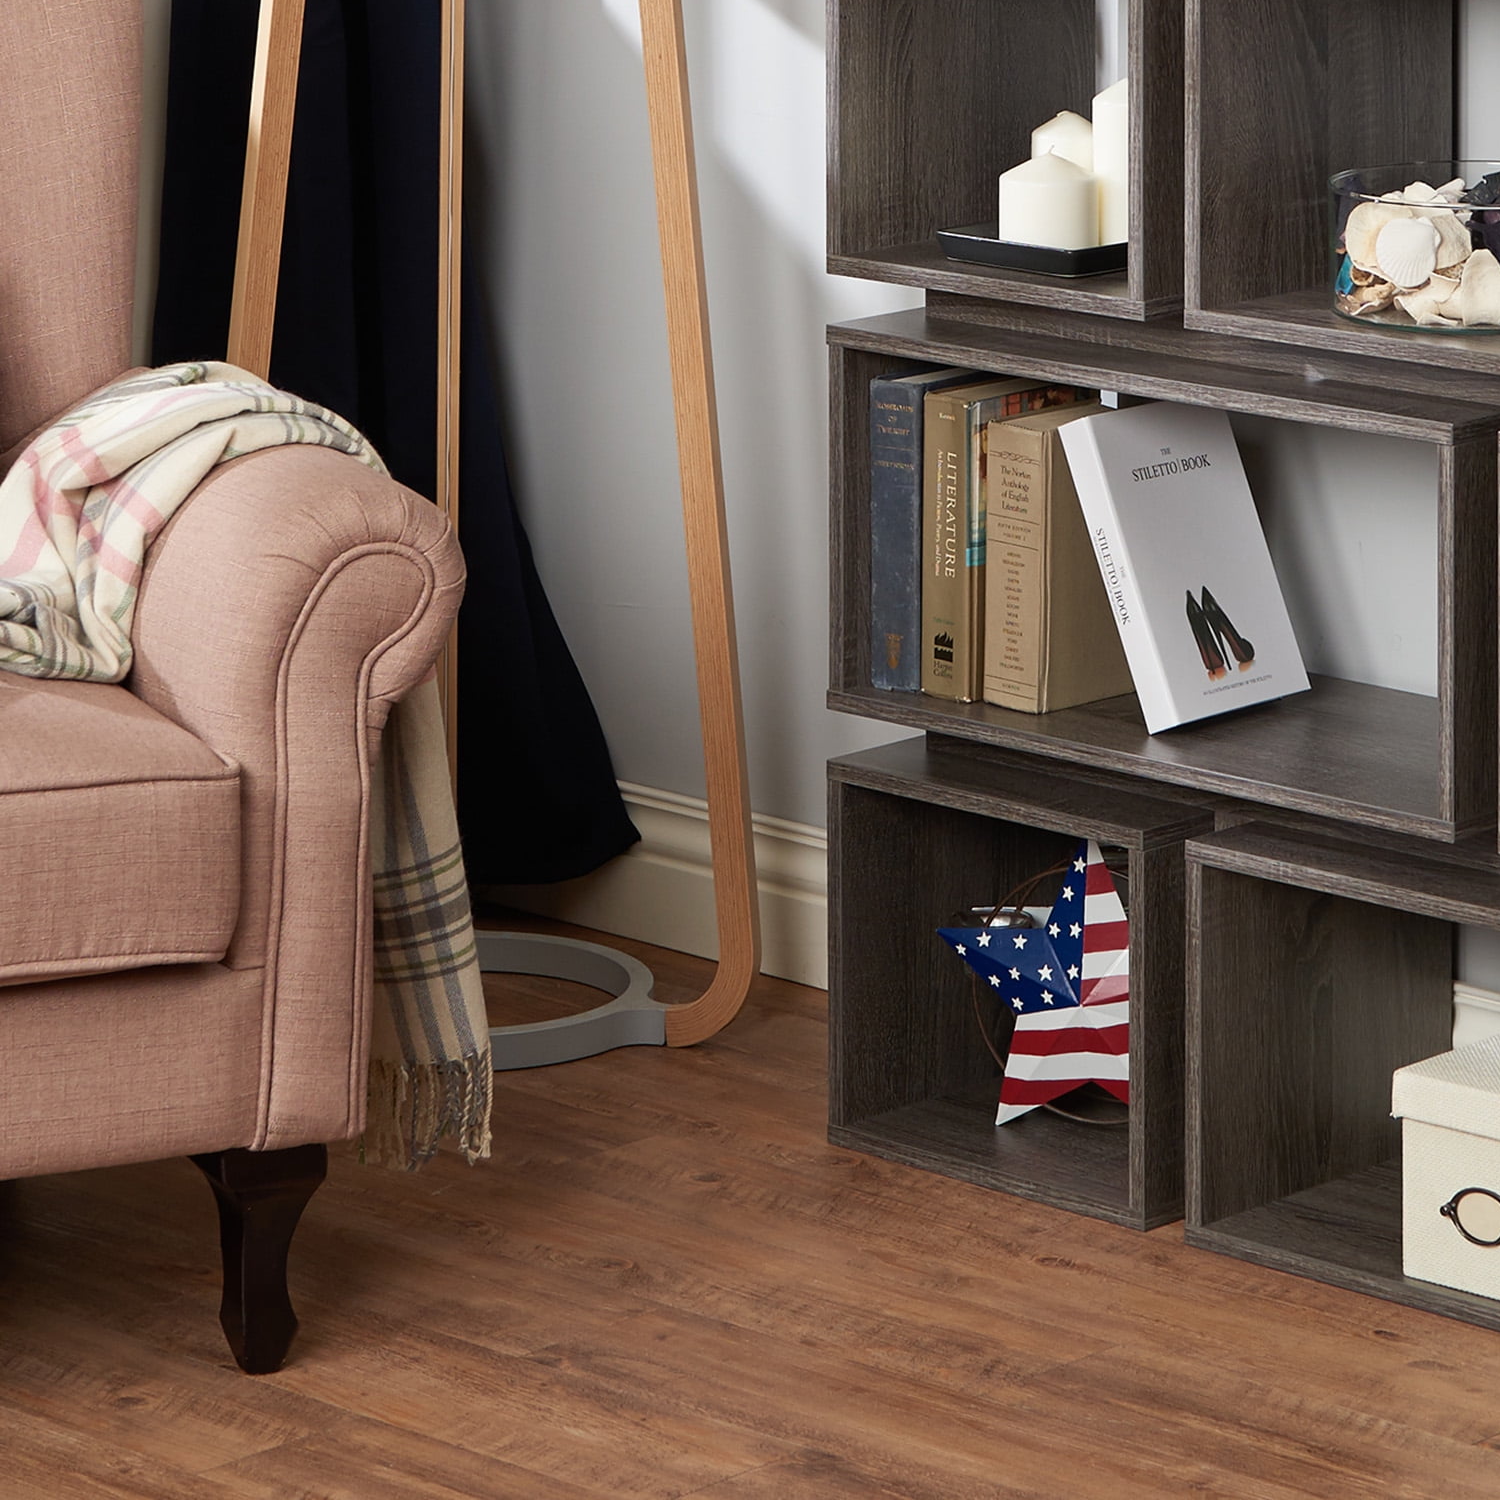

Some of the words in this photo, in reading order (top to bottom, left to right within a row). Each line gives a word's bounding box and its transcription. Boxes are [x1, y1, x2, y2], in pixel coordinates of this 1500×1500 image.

[945, 451, 957, 579] LITERATURE
[1132, 465, 1178, 482] STILETTO
[1182, 454, 1211, 476] BOOK
[1096, 528, 1118, 586] STILETTO
[1114, 591, 1131, 626] BOOK
